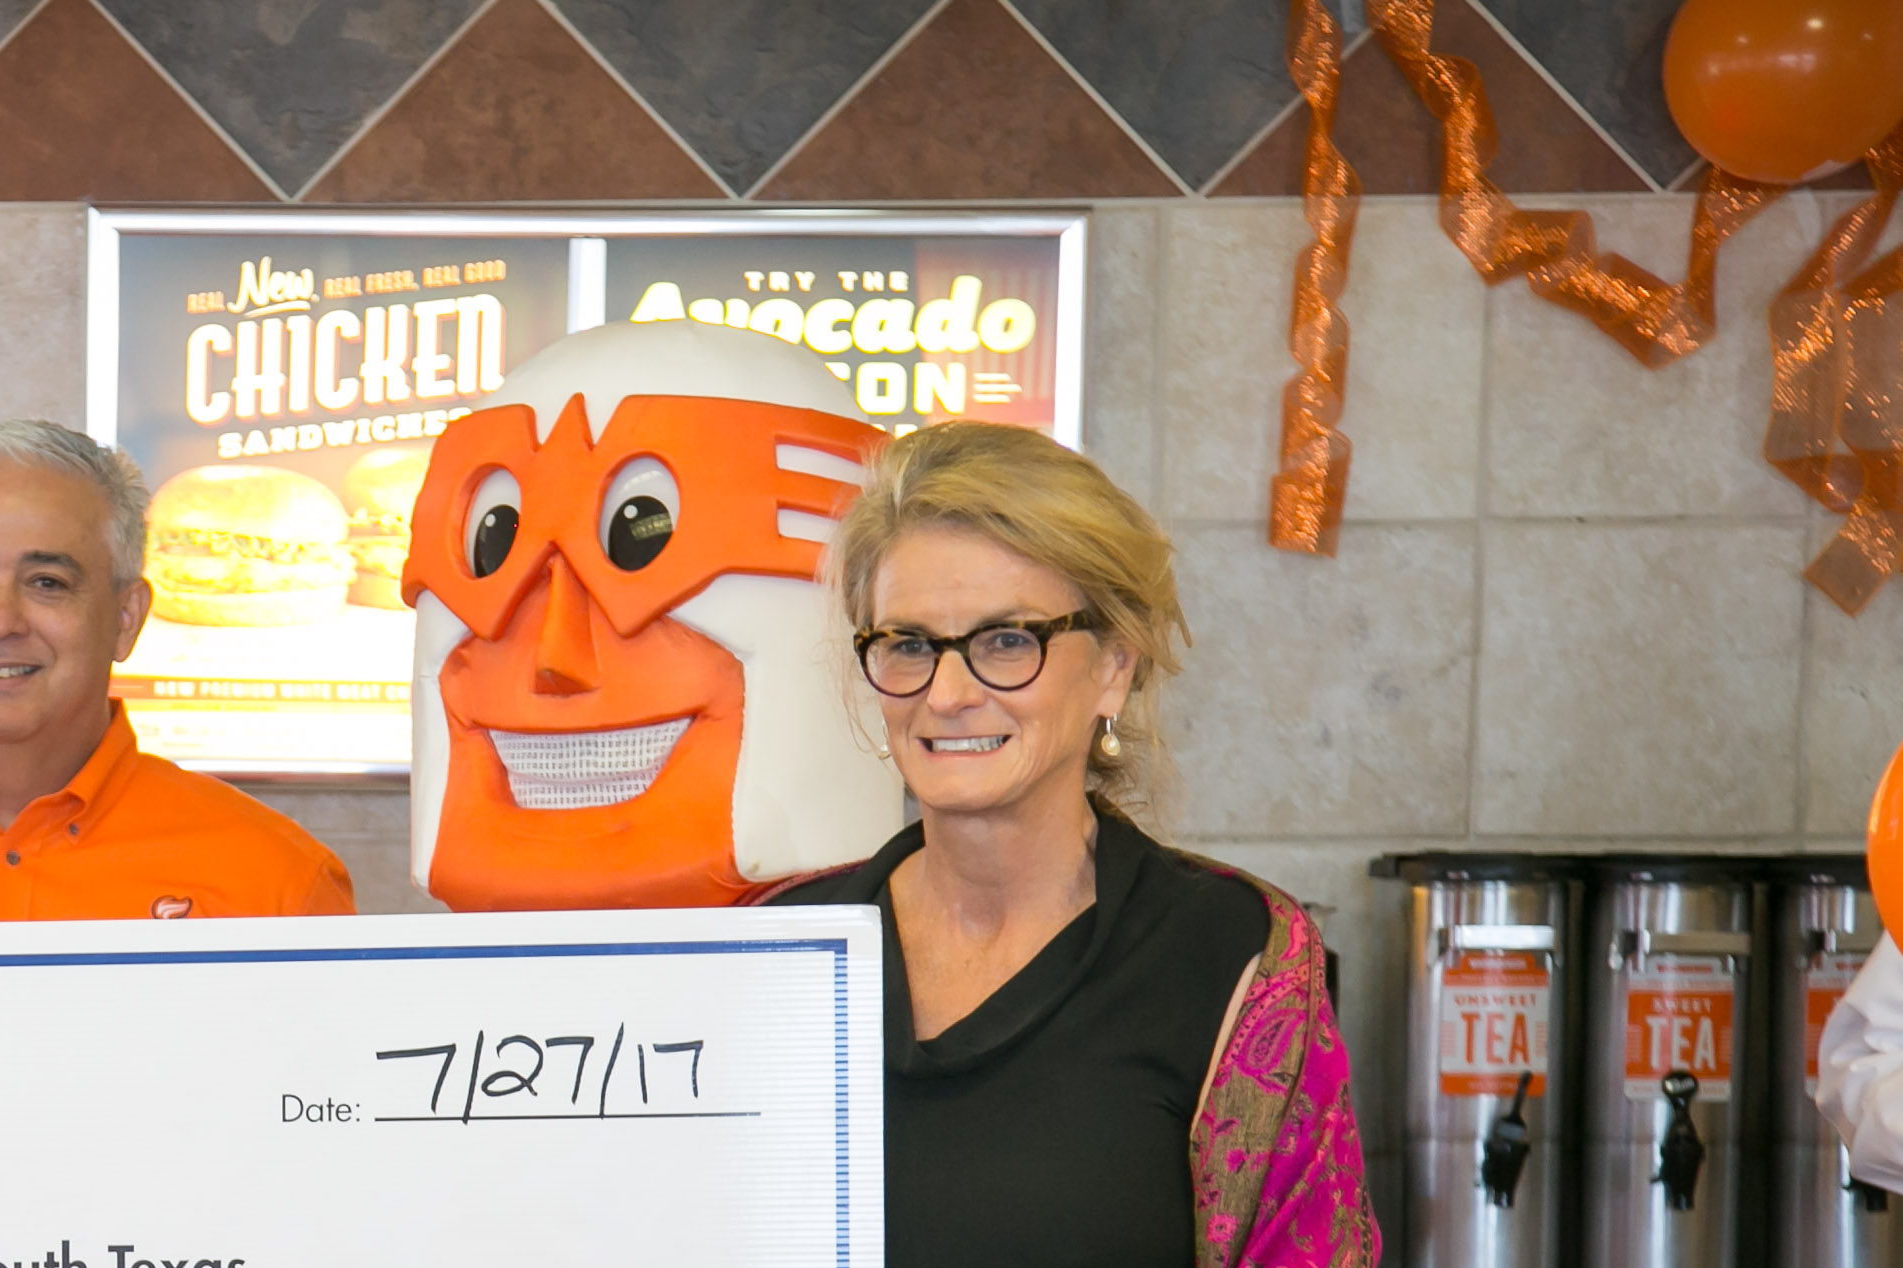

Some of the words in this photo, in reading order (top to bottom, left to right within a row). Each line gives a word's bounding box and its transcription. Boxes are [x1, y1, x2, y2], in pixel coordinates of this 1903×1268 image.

[187, 291, 225, 314] REAL
[324, 276, 362, 299] REAL
[422, 265, 461, 288] REAL
[744, 271, 816, 292] TRY
[838, 271, 909, 292] THE
[186, 293, 506, 427] CHICKEN
[1454, 993, 1538, 1008] UNSWEET
[1652, 998, 1714, 1013] SWEET
[1461, 1013, 1531, 1065] TEA
[1646, 1016, 1716, 1071] TEA
[282, 1094, 361, 1123] Date:
[376, 1023, 704, 1123] 7/27/17
